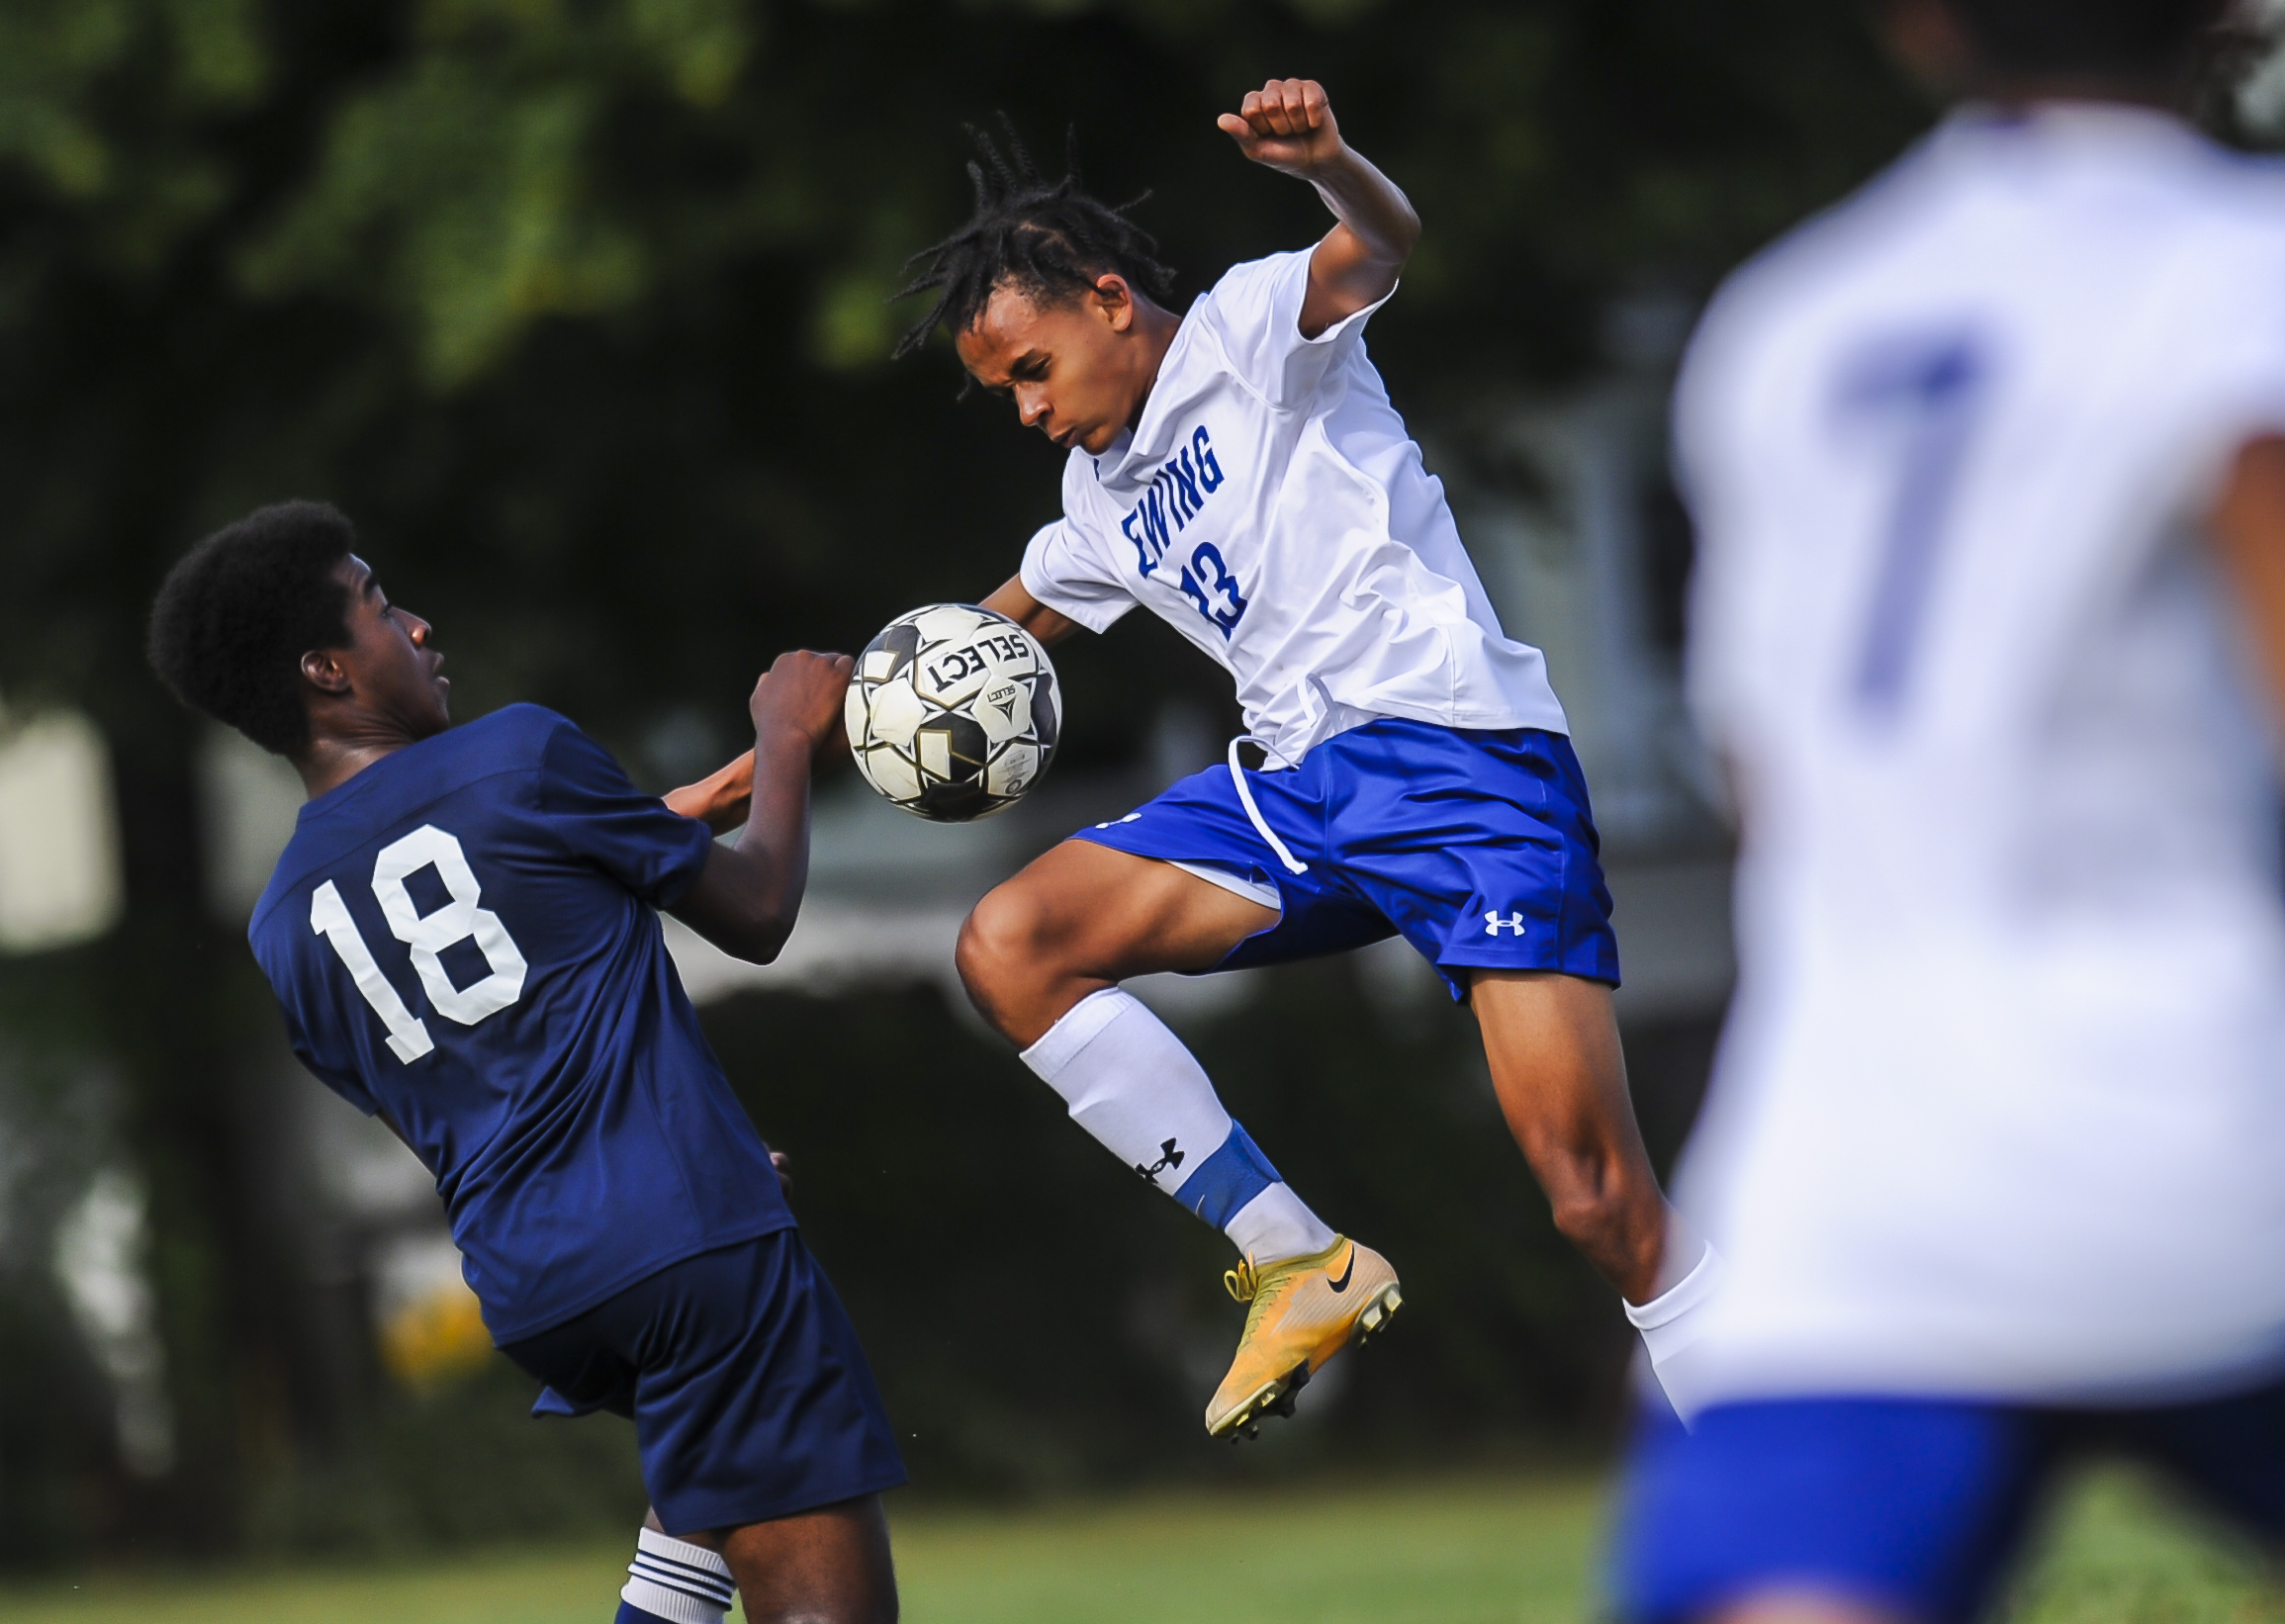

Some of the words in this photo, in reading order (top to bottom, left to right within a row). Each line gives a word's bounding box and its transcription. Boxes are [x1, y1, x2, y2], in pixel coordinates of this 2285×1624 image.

[1121, 424, 1226, 581] EWING
[1825, 309, 1996, 730] 7
[927, 634, 1030, 693] SELECT
[1179, 541, 1248, 643] 13
[310, 823, 528, 1066] 18
